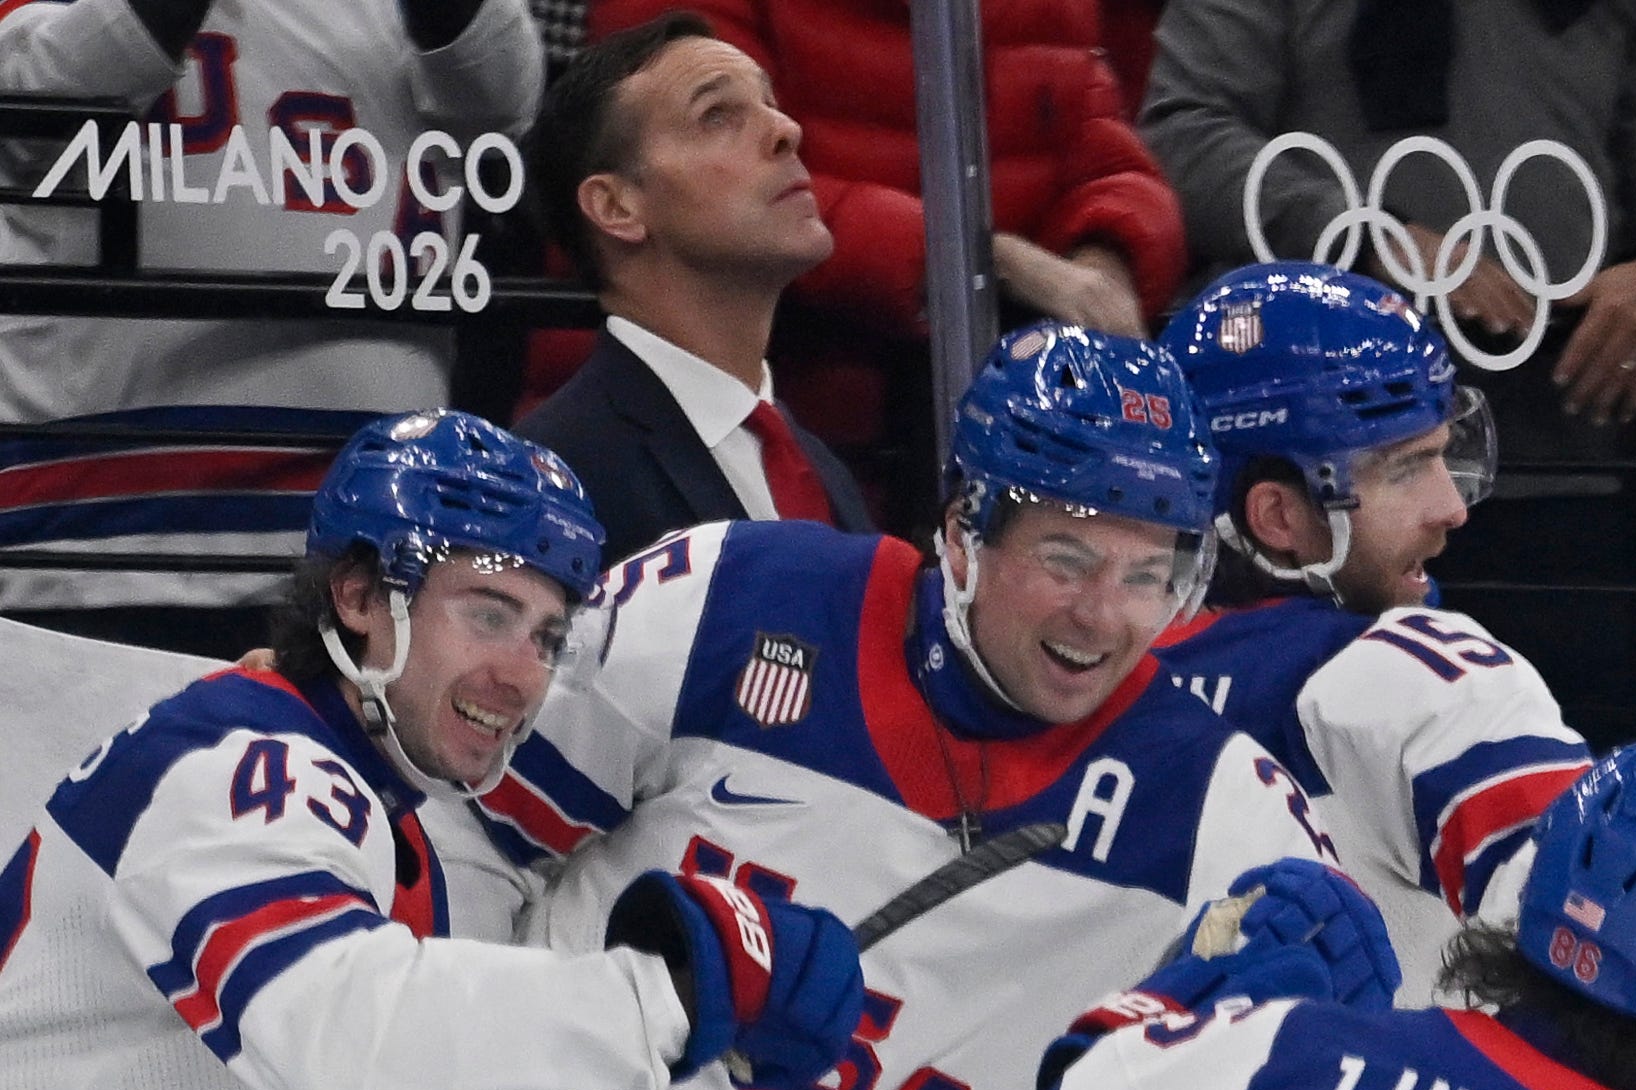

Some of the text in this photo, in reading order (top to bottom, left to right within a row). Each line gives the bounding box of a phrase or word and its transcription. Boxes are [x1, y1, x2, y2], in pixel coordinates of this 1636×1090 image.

[32, 119, 388, 209] MILANO
[324, 229, 491, 312] 2026
[1120, 388, 1174, 431] 25
[1211, 407, 1289, 432] CCM
[762, 638, 805, 669] USA
[1361, 614, 1514, 683] 15
[229, 736, 373, 851] 43
[1067, 757, 1135, 862] A
[1548, 926, 1603, 984] 86
